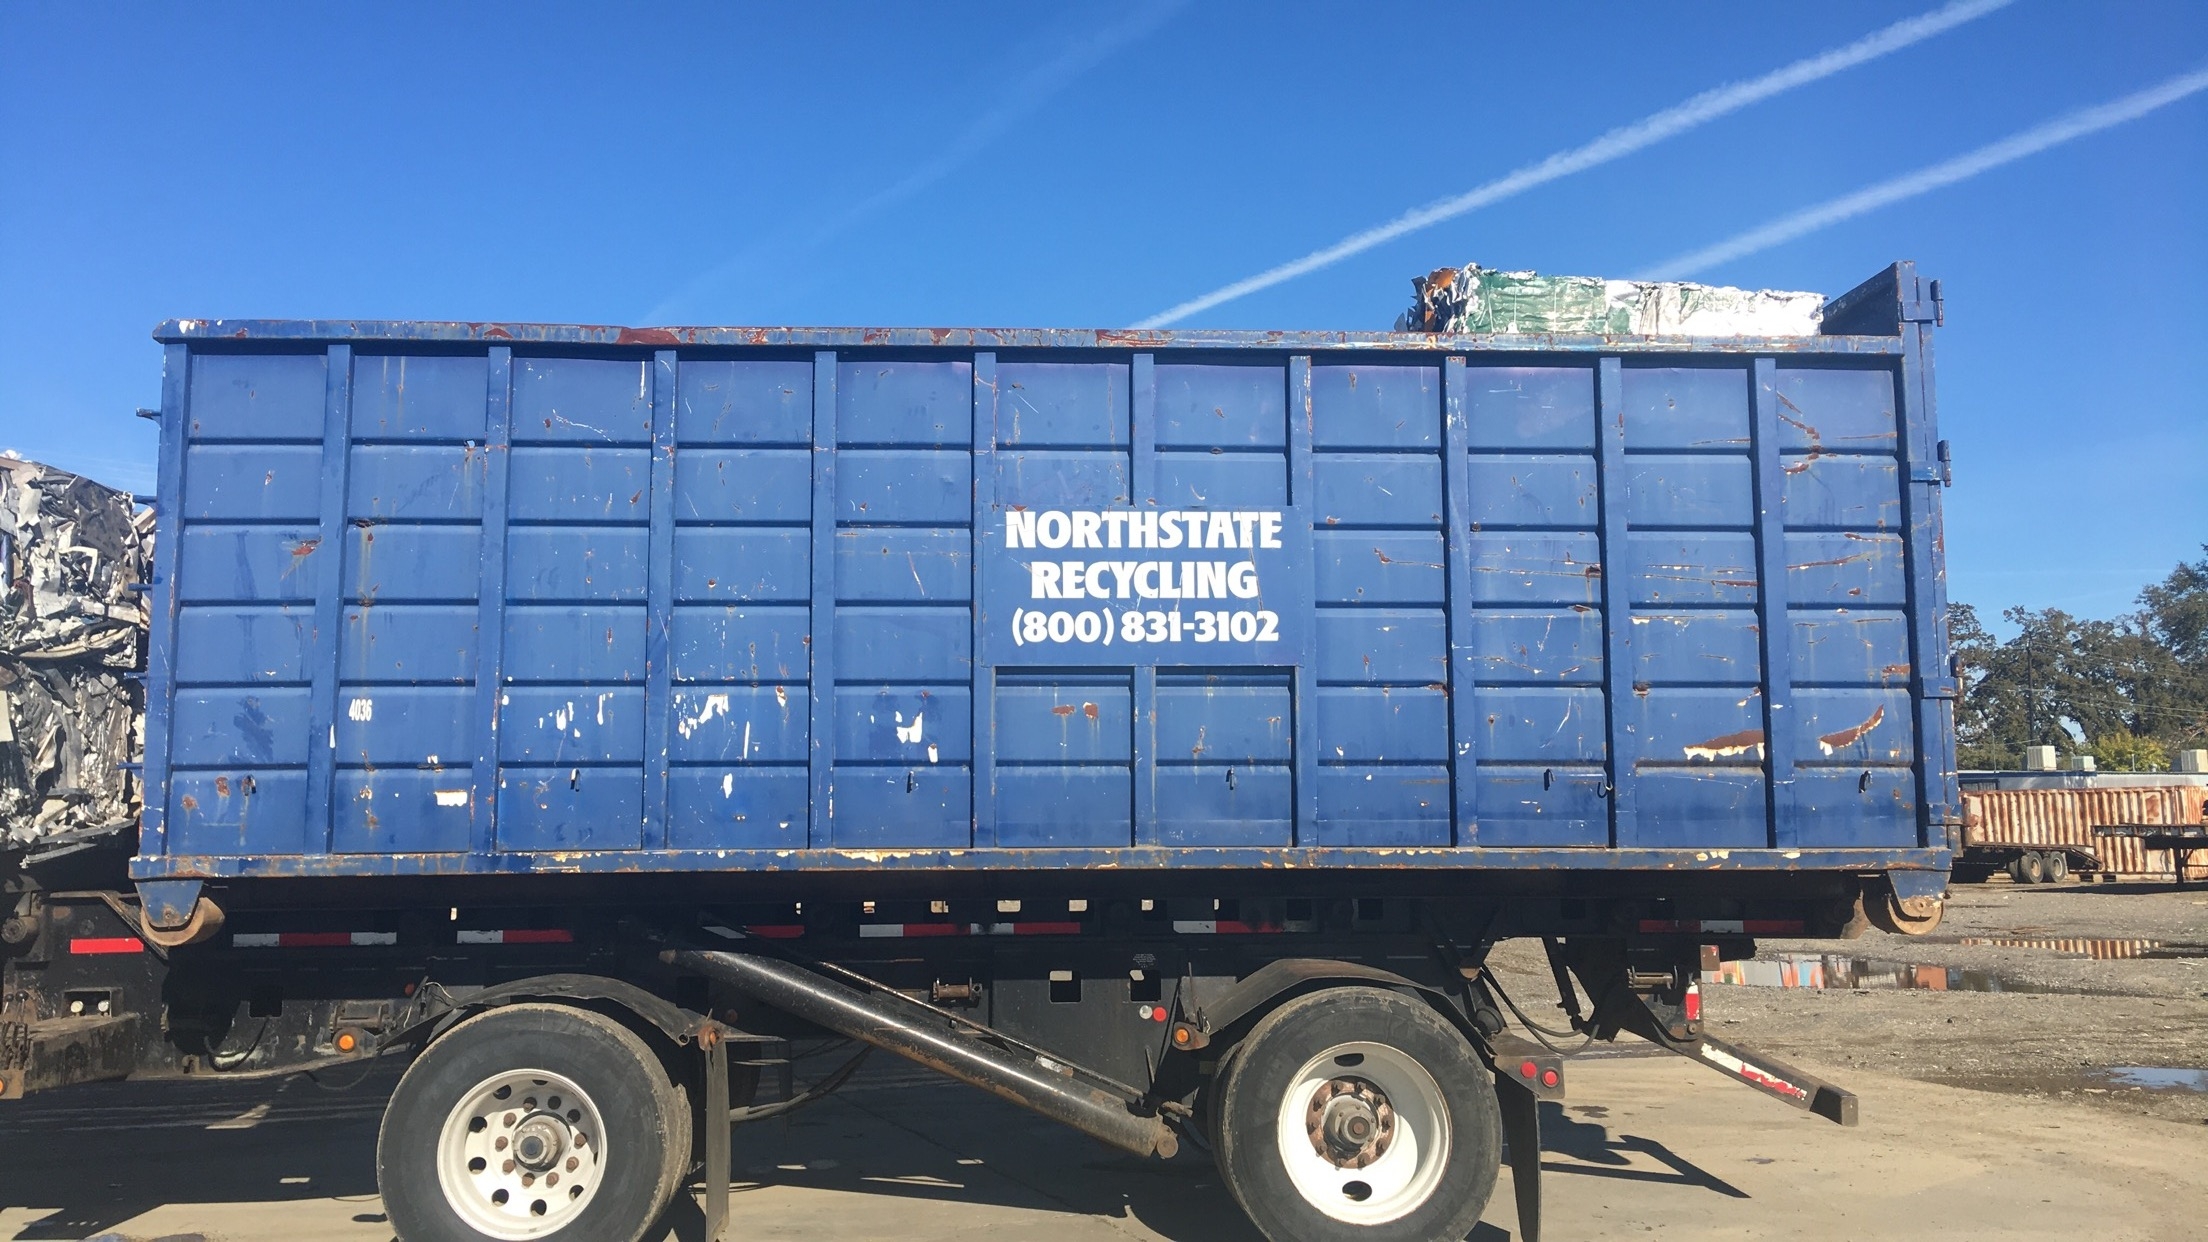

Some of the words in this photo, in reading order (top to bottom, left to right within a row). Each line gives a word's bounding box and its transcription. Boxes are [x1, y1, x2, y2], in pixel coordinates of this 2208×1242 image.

[1006, 511, 1282, 549] NORTHSTATE
[1031, 562, 1259, 599] RECYCLING
[1012, 608, 1114, 647] (800)
[1121, 611, 1280, 643] 831-3102
[348, 698, 373, 721] 4036
